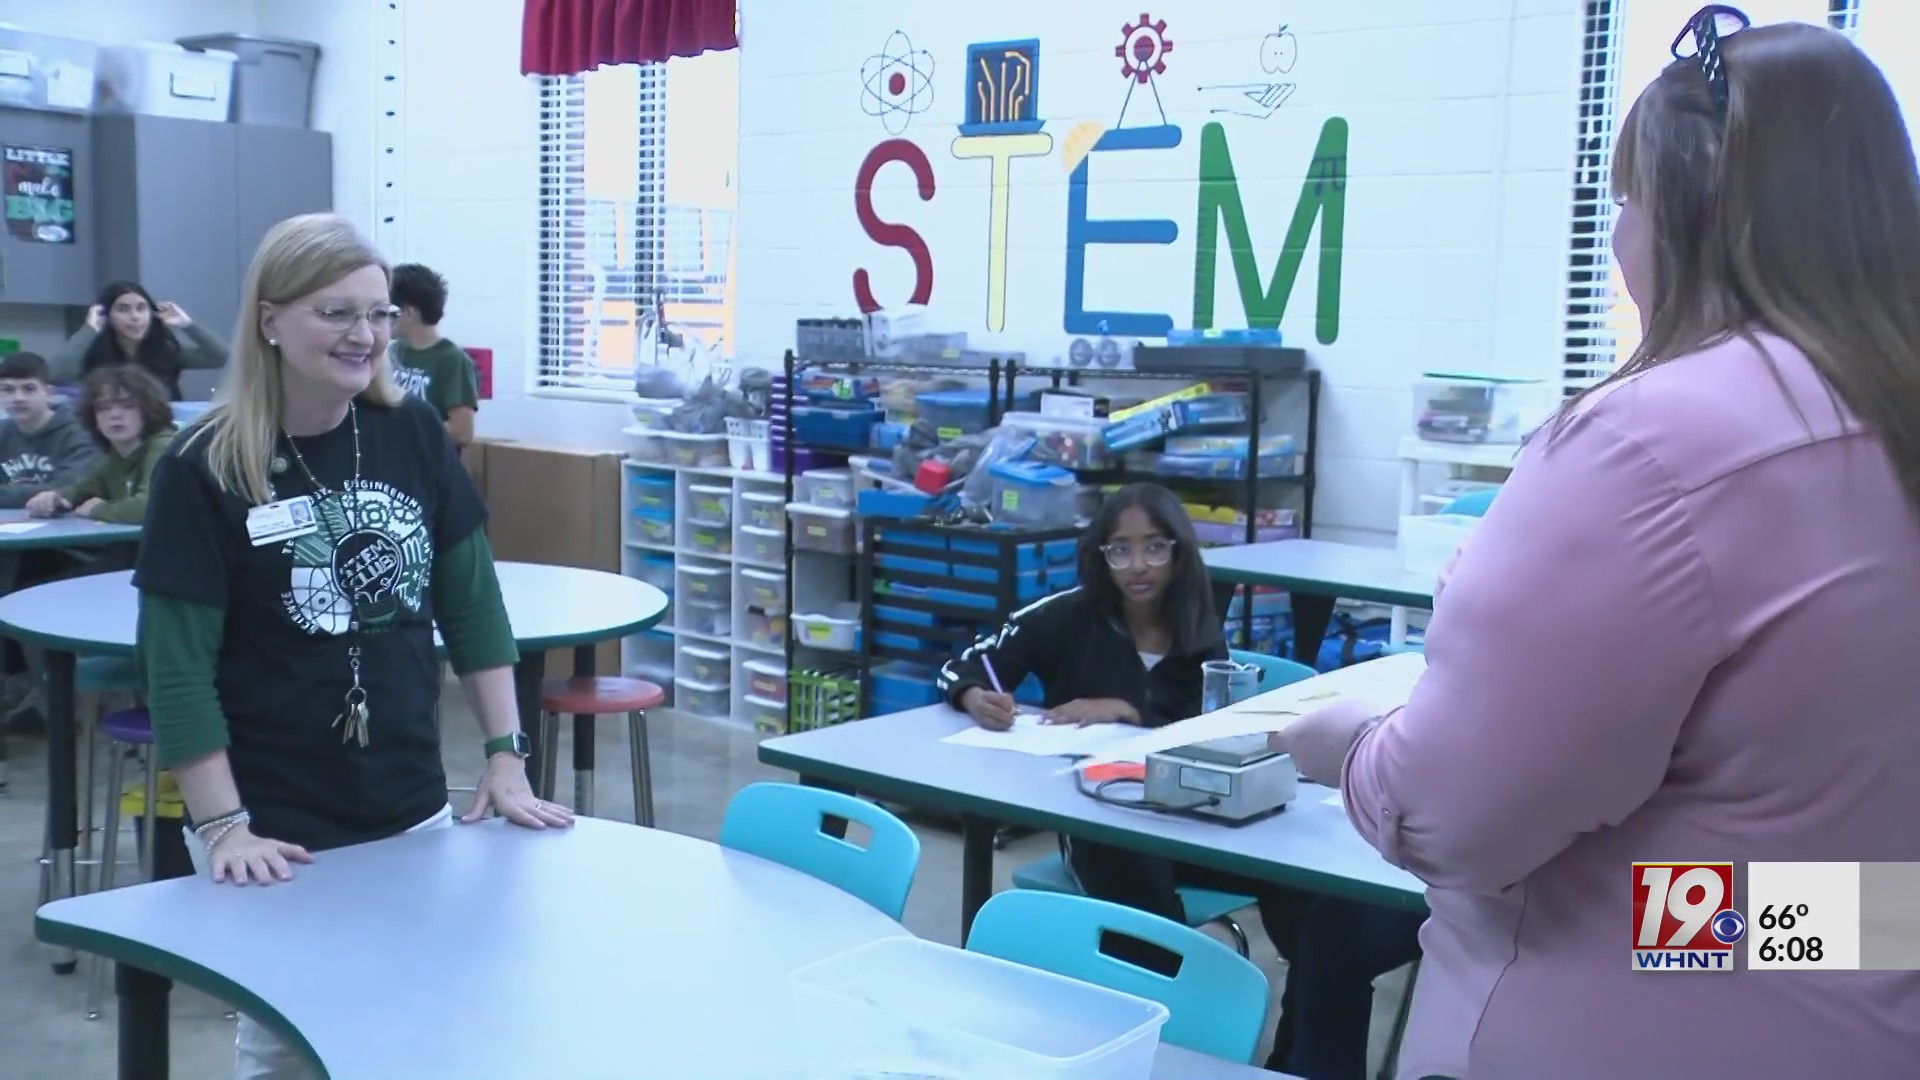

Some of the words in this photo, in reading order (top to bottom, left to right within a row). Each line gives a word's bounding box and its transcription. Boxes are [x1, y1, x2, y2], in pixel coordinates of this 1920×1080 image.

[6, 147, 70, 166] LITTLE
[853, 116, 1349, 345] STEM
[341, 553, 398, 590] CLUB
